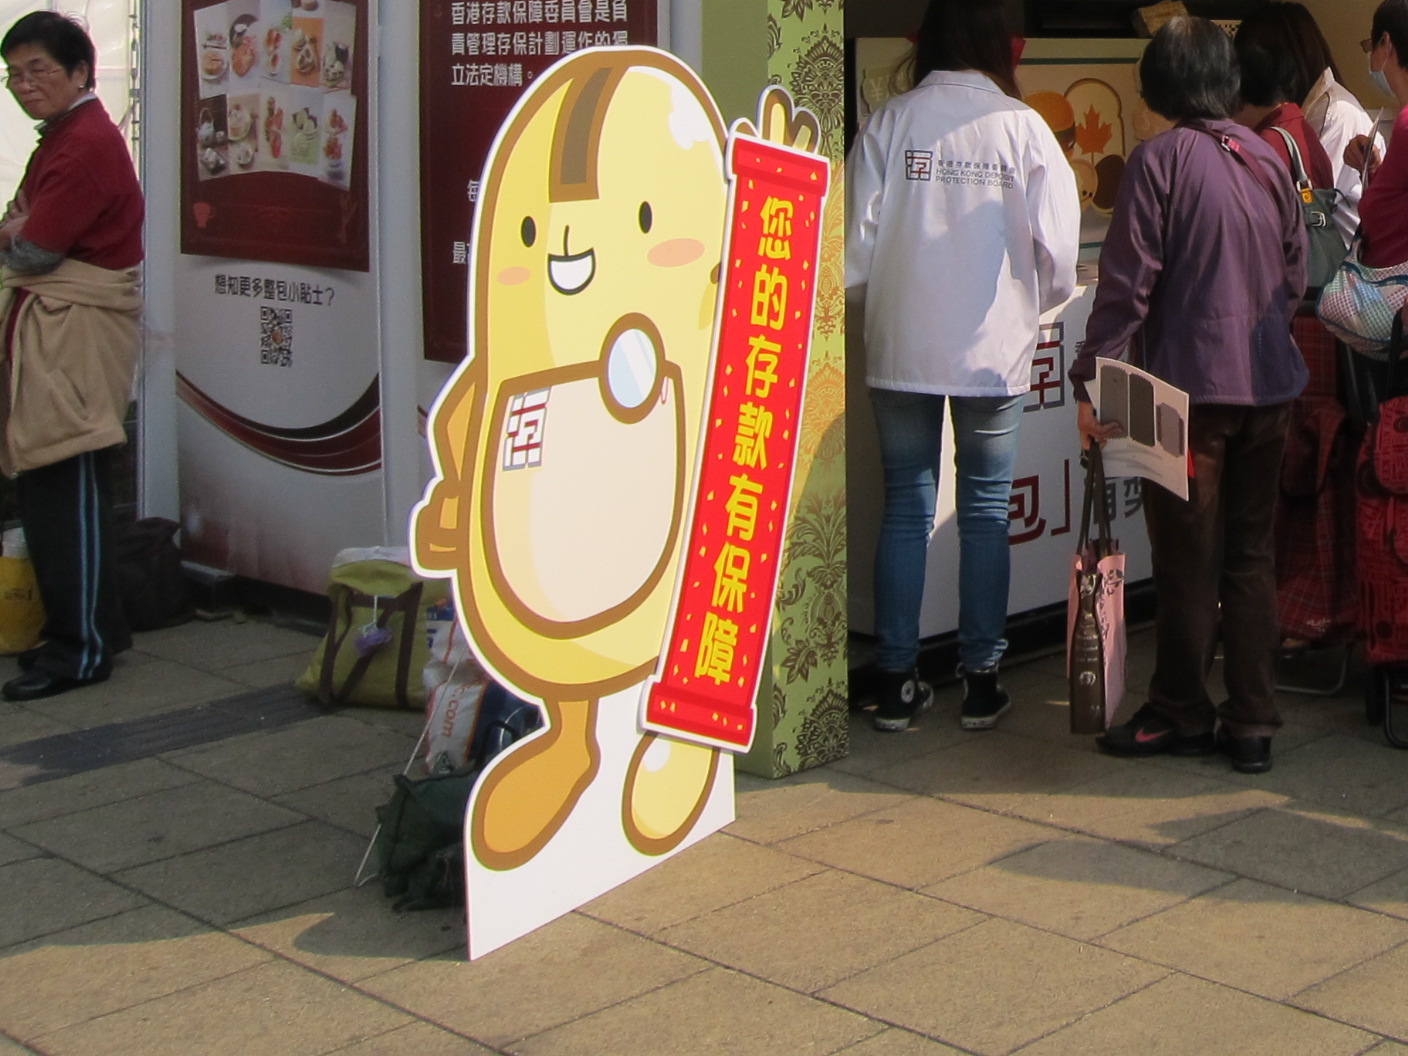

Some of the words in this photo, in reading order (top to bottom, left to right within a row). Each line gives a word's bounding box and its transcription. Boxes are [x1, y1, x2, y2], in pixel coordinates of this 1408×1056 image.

[451, 63, 534, 87] 立法定機構。
[936, 168, 959, 177] HONG
[960, 170, 983, 178] KONG
[985, 171, 1015, 182] DEPOSIT
[936, 175, 986, 186] PROTECTION
[988, 179, 1014, 190] BOARD
[694, 195, 795, 686] 您的存款有保障
